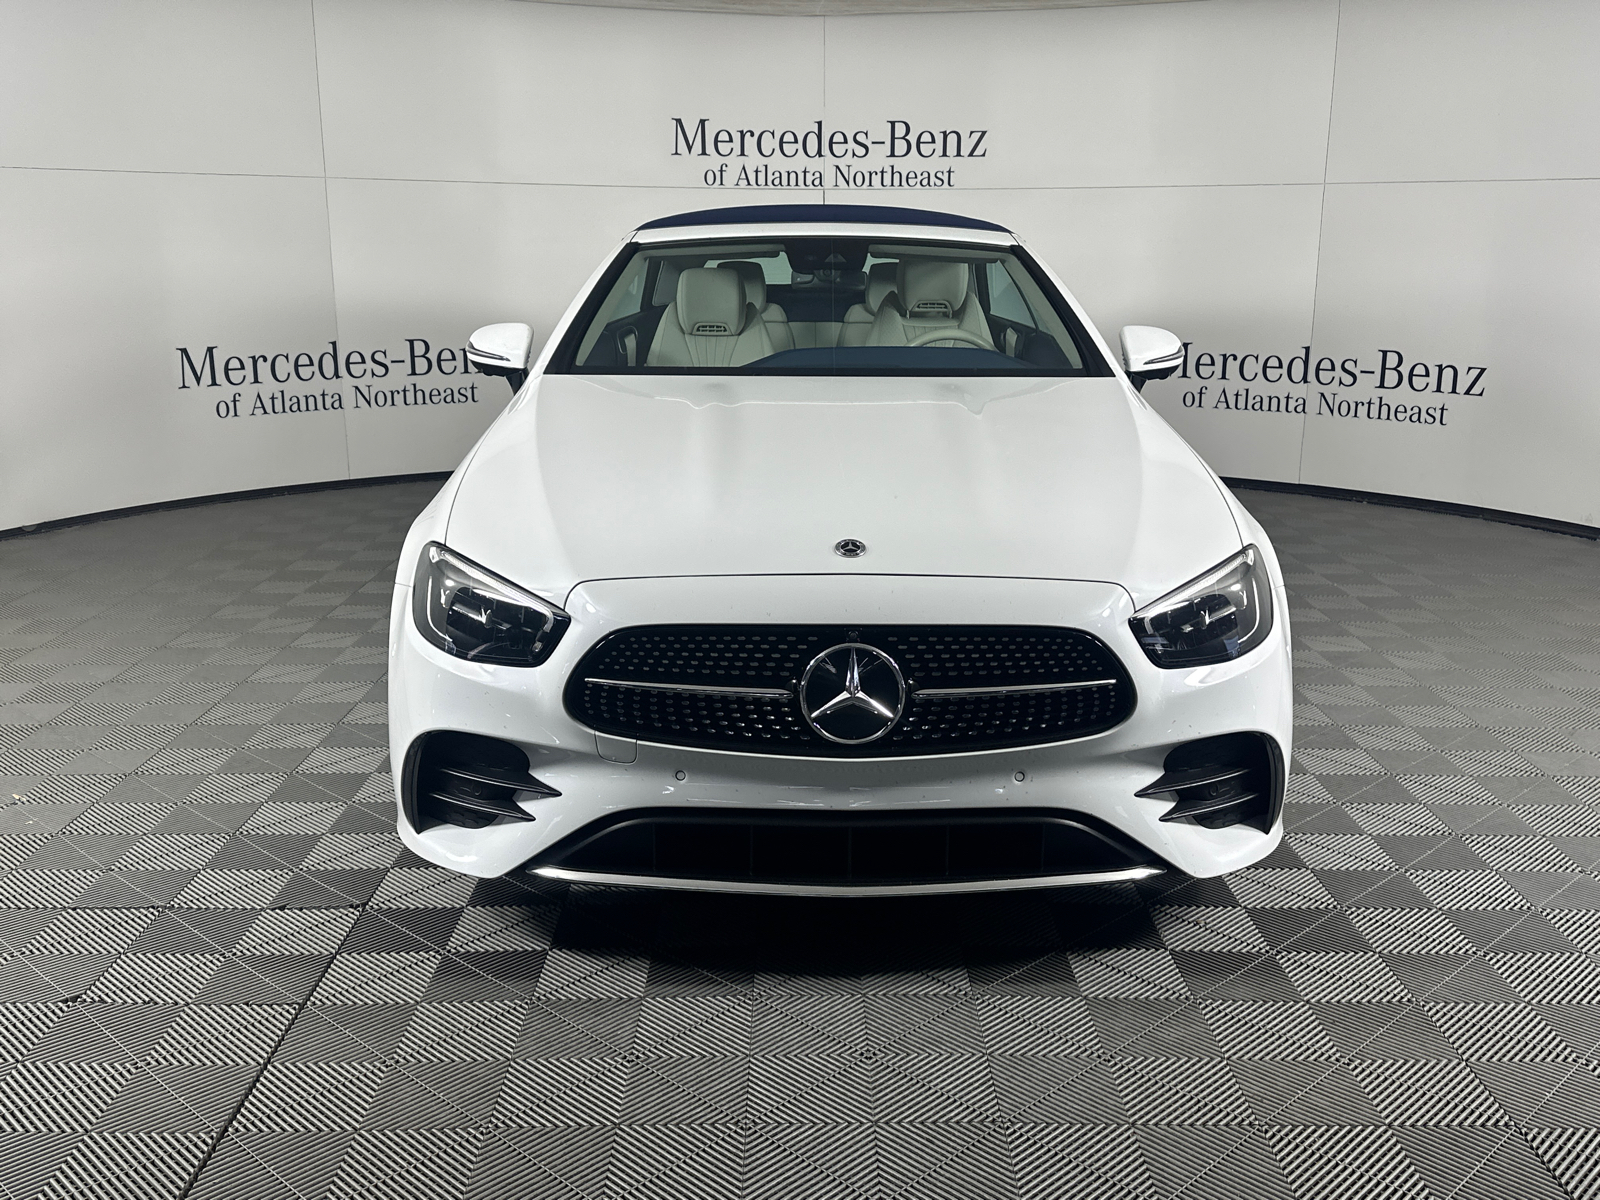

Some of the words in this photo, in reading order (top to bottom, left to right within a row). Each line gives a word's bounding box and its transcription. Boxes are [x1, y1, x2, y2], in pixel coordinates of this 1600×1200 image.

[671, 117, 988, 158] Mercedes-Benz
[703, 163, 727, 187] of
[735, 164, 824, 188] Atlanta
[833, 164, 955, 188] Northeast
[176, 338, 484, 390] Mercedes-Ben
[215, 392, 242, 419] of
[249, 389, 345, 417] Atlanta
[353, 382, 479, 410] Northeast
[1182, 385, 1208, 409] of
[1212, 386, 1307, 415] Atlanta
[1316, 391, 1449, 426] Northeast
